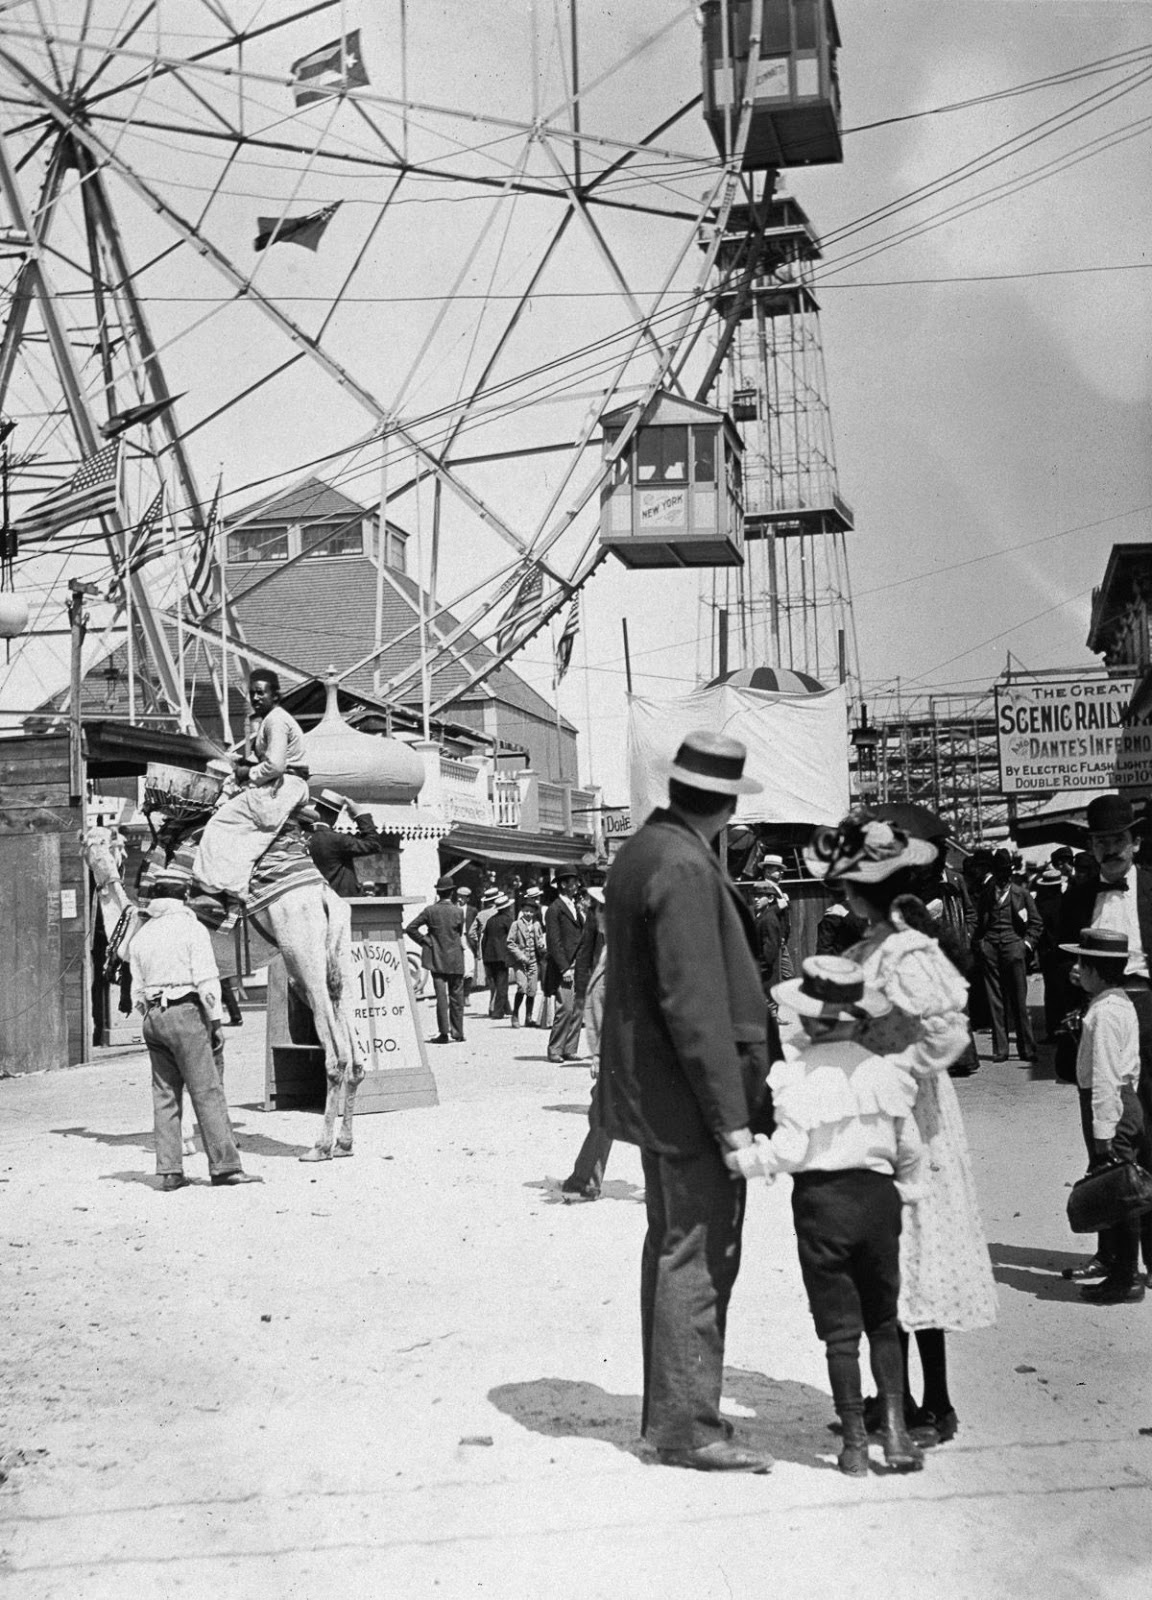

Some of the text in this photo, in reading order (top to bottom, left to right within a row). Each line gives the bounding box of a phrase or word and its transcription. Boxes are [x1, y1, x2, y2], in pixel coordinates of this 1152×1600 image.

[642, 494, 683, 520] NEW YORK
[1032, 683, 1132, 699] THE GREAT
[1000, 704, 1072, 735] SCENIC
[1030, 737, 1088, 759] DANTE'S
[1089, 734, 1151, 756] INFERNO
[1006, 766, 1020, 776] BY
[1022, 764, 1078, 776] ELECTRIC
[1080, 761, 1114, 773] FLASH
[1016, 769, 1152, 789] DOUBLE ROUND TRIP 10
[350, 945, 400, 971] MISSION
[354, 1005, 405, 1018] REETS OF
